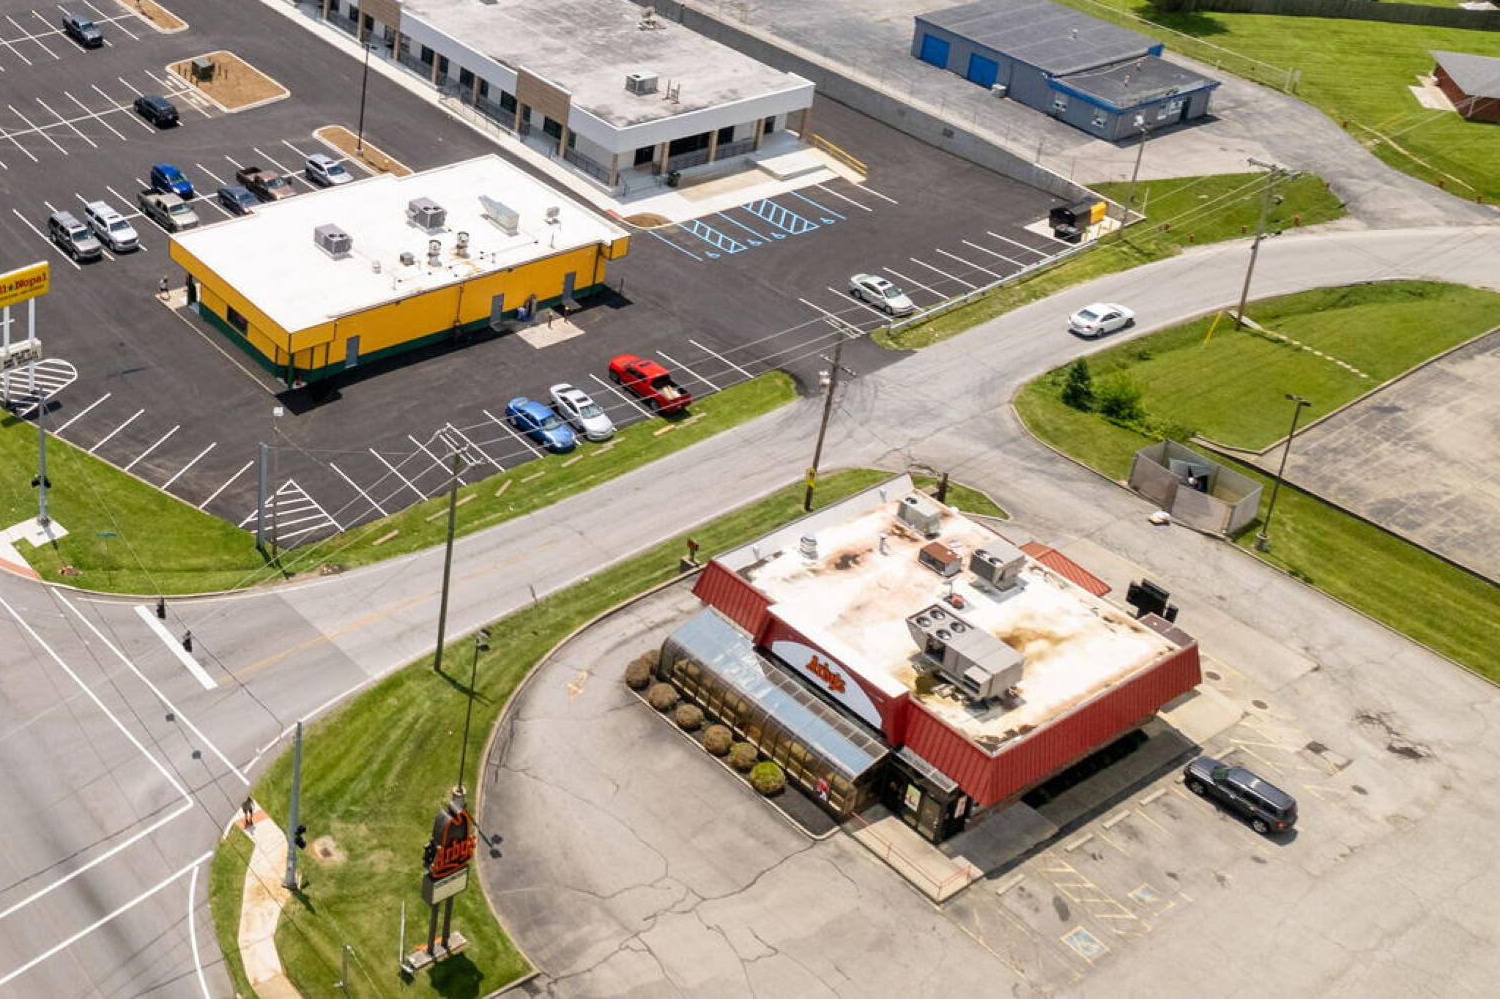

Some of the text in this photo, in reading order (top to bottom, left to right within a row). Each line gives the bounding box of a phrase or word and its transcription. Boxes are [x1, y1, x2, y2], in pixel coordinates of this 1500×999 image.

[15, 272, 47, 290] Nopal
[805, 655, 846, 694] Arby's
[432, 834, 476, 873] Arby's
